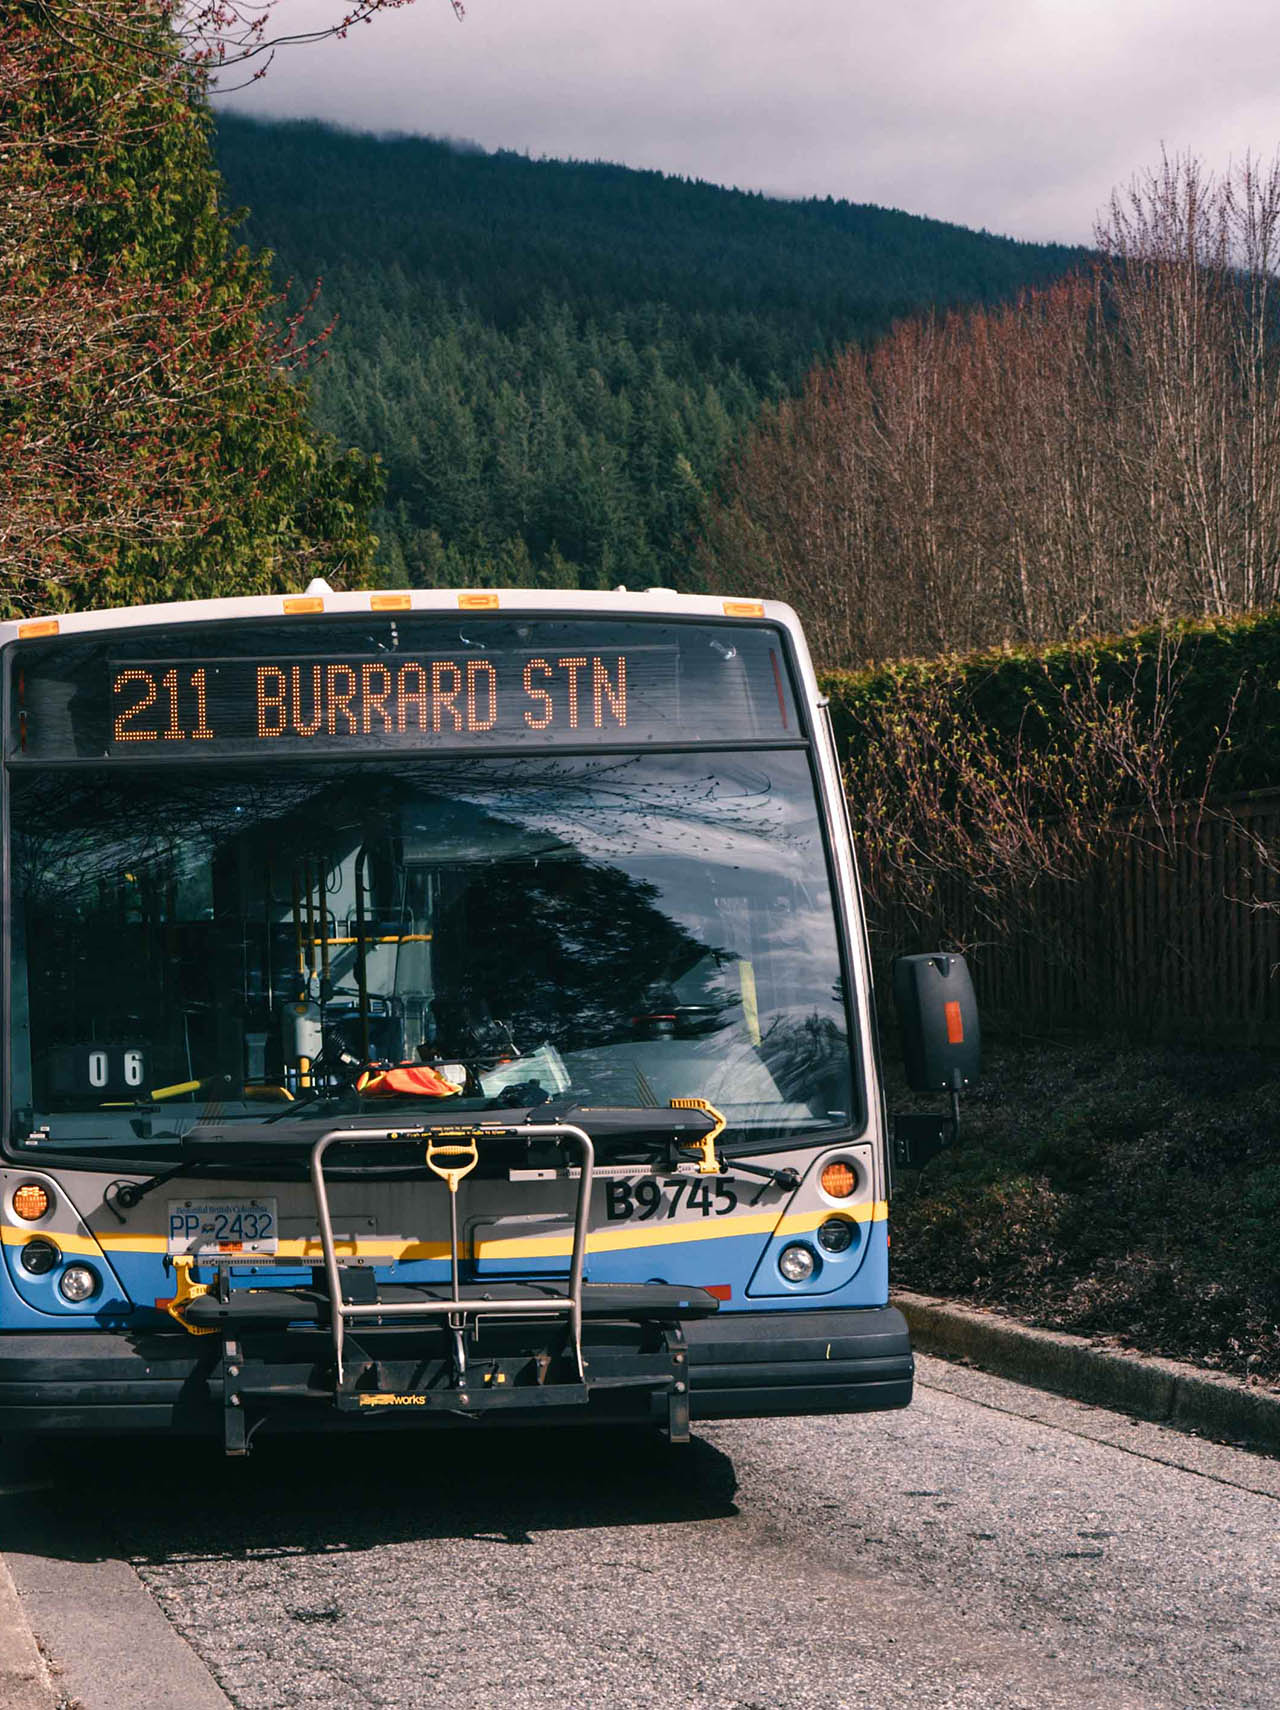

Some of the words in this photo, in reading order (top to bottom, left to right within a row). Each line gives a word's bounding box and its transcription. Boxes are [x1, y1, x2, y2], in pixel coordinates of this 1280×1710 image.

[113, 667, 215, 742] 211
[257, 659, 498, 738] BURRARD
[522, 655, 626, 730] STN
[606, 1177, 738, 1221] B9745
[170, 1215, 200, 1240] PP
[214, 1213, 273, 1240] 2432
